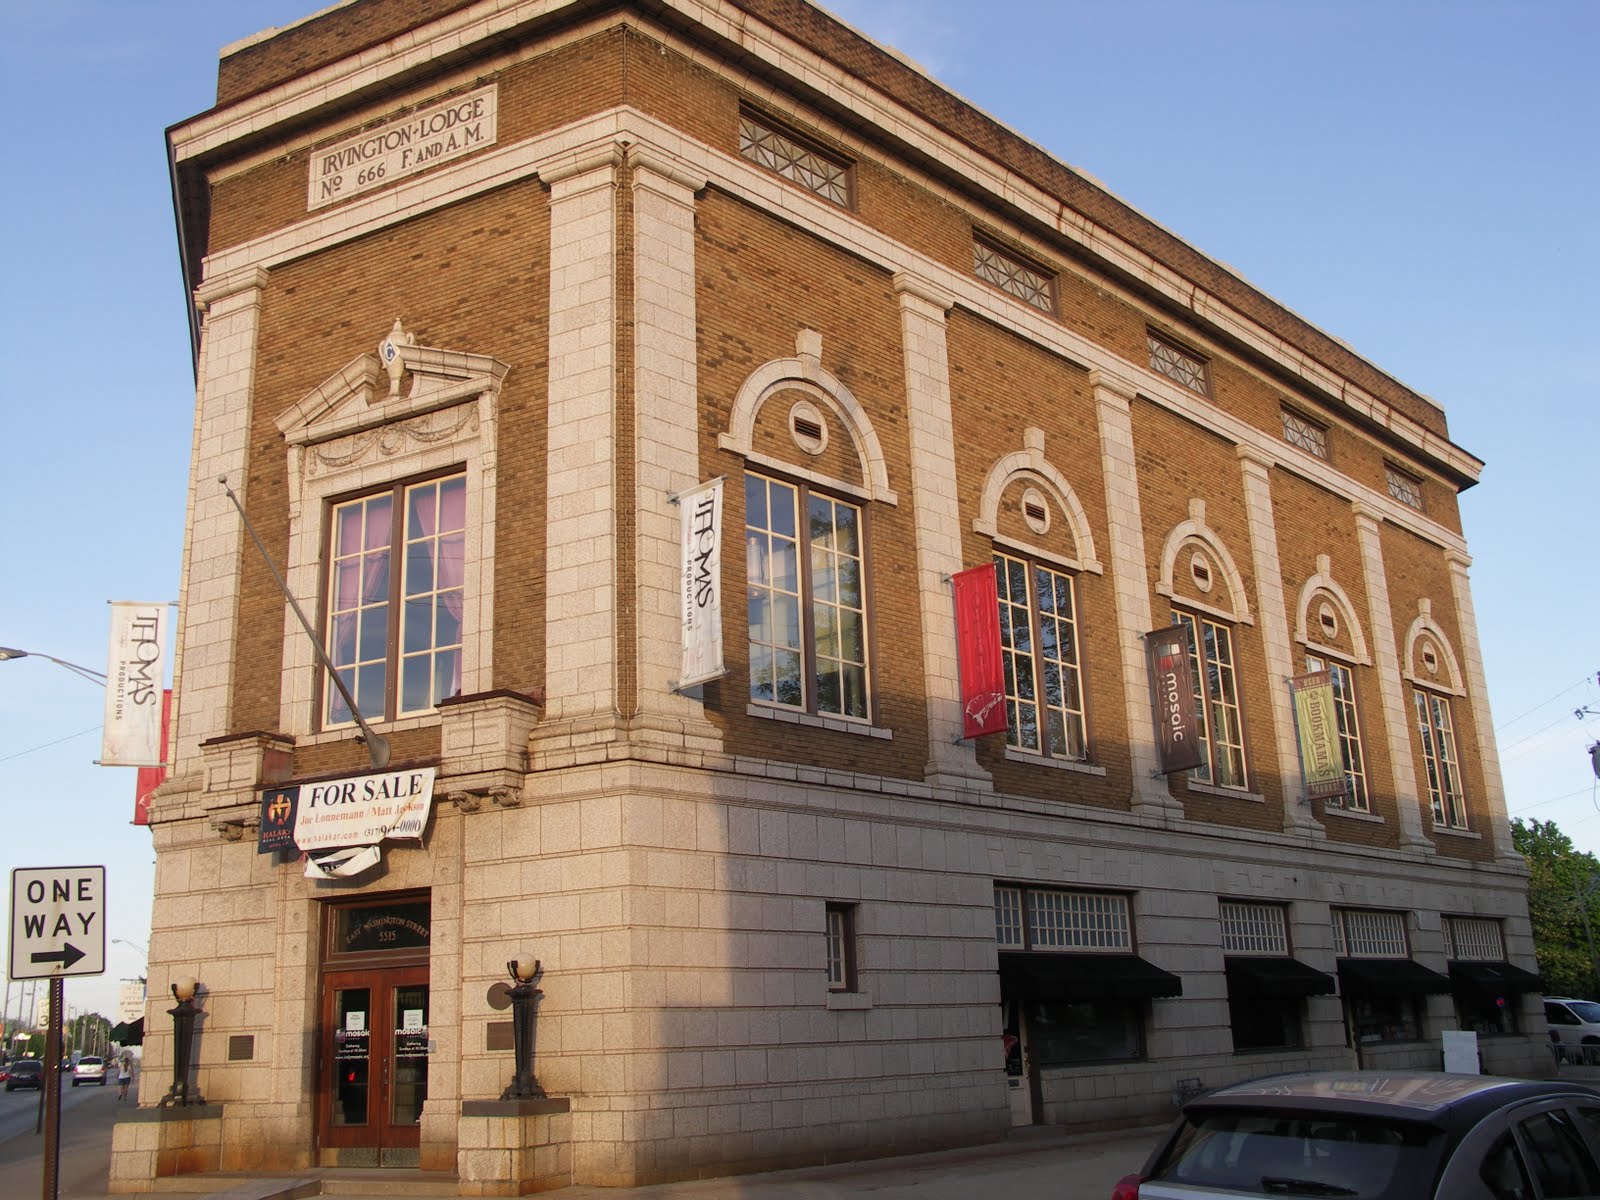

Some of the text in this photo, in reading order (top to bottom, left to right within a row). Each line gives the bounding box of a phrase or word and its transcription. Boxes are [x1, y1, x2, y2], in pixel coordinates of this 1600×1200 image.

[357, 162, 386, 185] 666
[401, 150, 413, 169] F.
[415, 142, 443, 163] AND
[694, 488, 716, 608] THOMAS
[128, 608, 160, 706] THOMAS
[115, 660, 126, 721] PRODUCTIONS
[1166, 672, 1186, 742] mosaic
[1310, 700, 1331, 777] BOOKMAMAS
[308, 774, 423, 808] FOR SALE
[300, 814, 313, 825] Joe
[315, 811, 364, 824] Lonnemann
[371, 806, 392, 816] Matt
[27, 878, 93, 904] ONE
[24, 911, 96, 939] WAY
[406, 920, 429, 938] STREET
[345, 1028, 370, 1038] mosaic
[394, 1028, 422, 1036] mosaic
